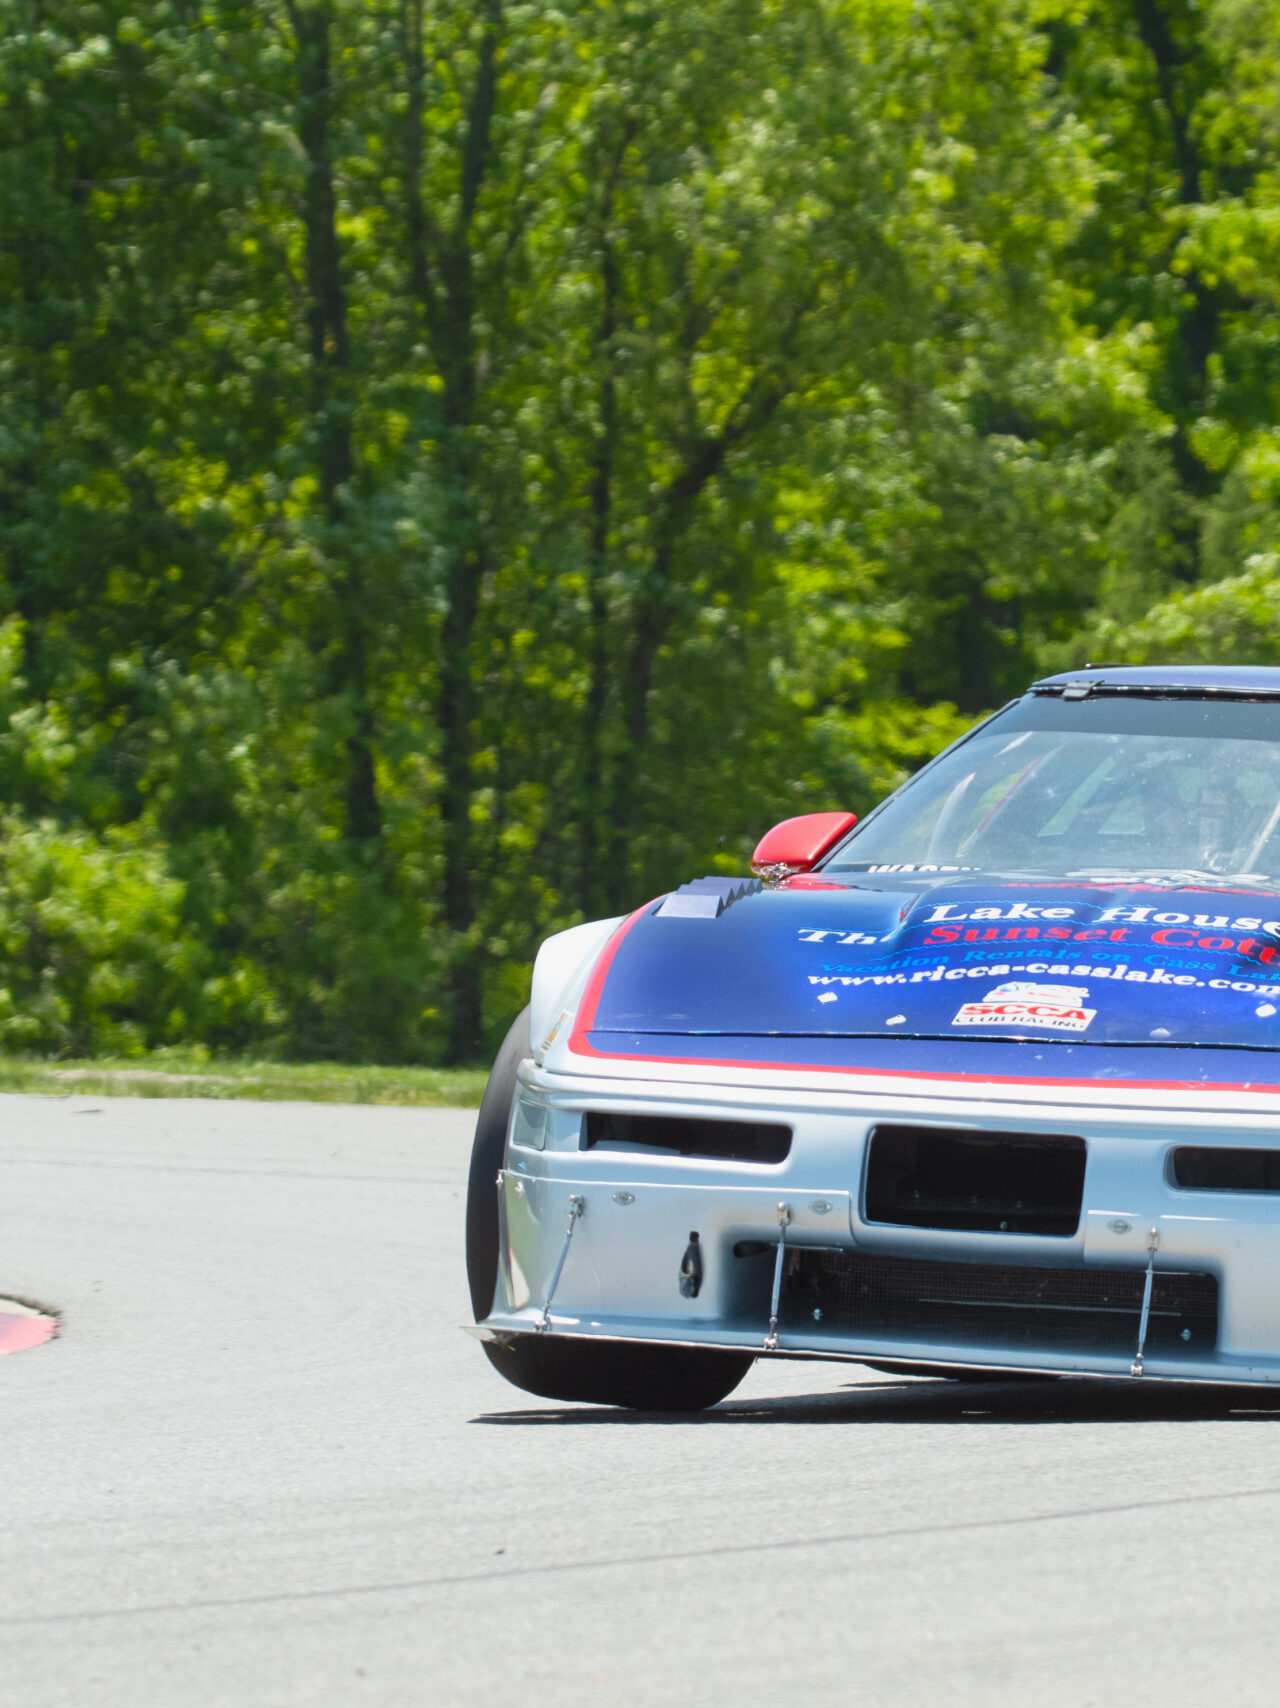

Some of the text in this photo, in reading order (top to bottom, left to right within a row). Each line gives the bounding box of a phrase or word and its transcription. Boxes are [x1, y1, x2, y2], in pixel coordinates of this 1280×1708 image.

[923, 903, 1075, 923] Lake
[923, 924, 1132, 945] Sunset
[821, 955, 949, 973] Vacation
[962, 949, 1083, 963] Rentals
[1091, 951, 1130, 963] on
[1143, 954, 1216, 971] Cass
[962, 1004, 1087, 1020] SCCA
